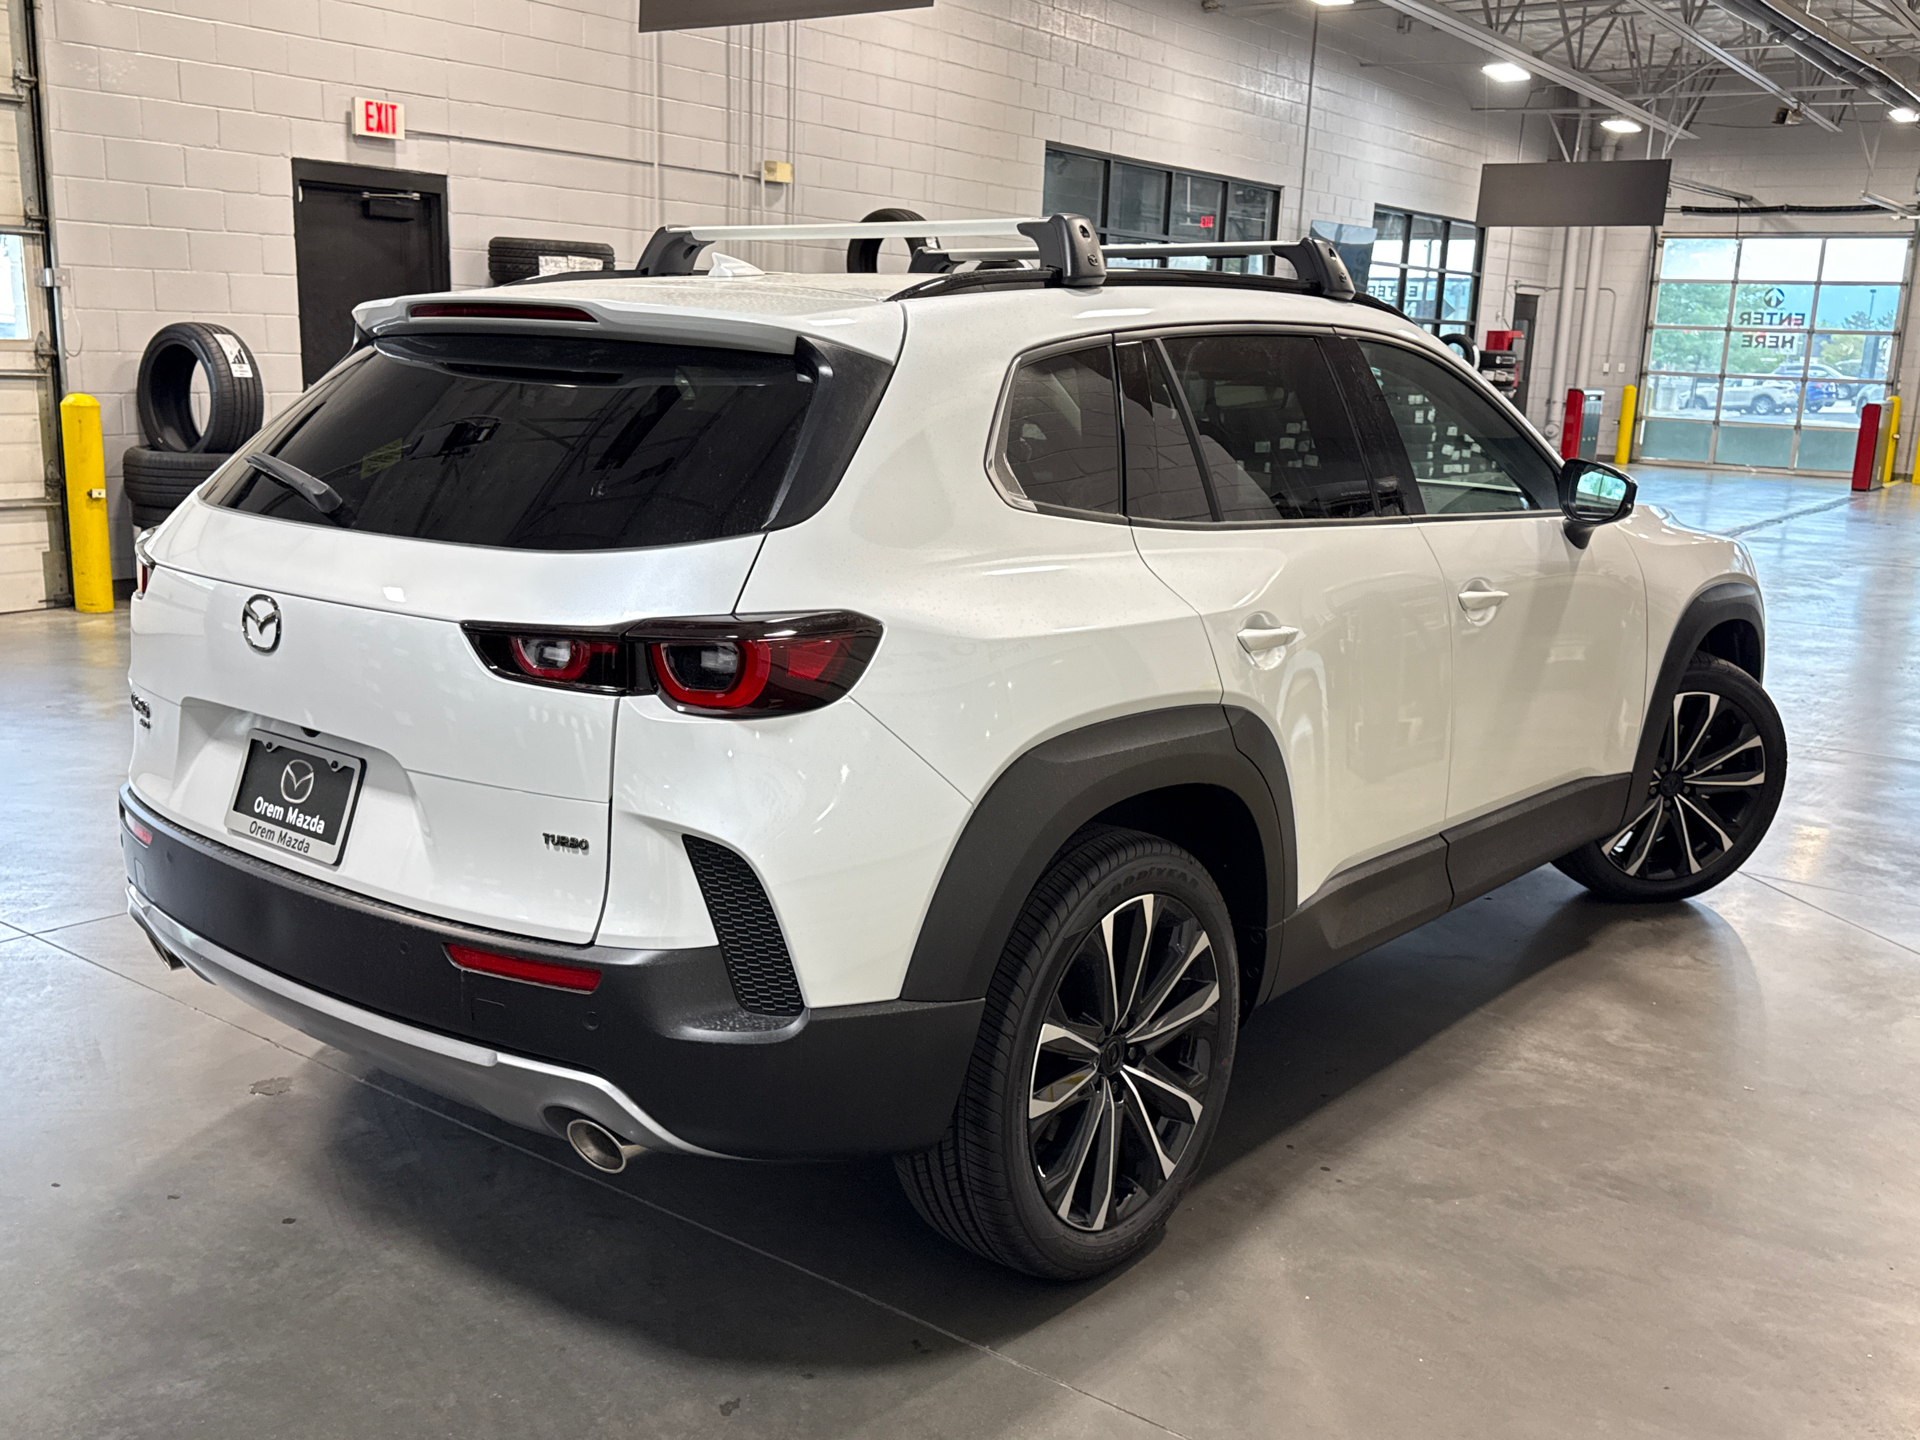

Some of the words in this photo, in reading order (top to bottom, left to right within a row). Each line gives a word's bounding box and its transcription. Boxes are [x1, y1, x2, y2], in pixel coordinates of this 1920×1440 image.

[365, 100, 398, 135] EXIT
[253, 796, 284, 821] Orem
[285, 806, 326, 834] Mazda
[249, 820, 276, 841] Orem
[276, 829, 311, 854] Mazda
[542, 832, 590, 850] TURBO
[1097, 866, 1199, 908] GOODYEAR
